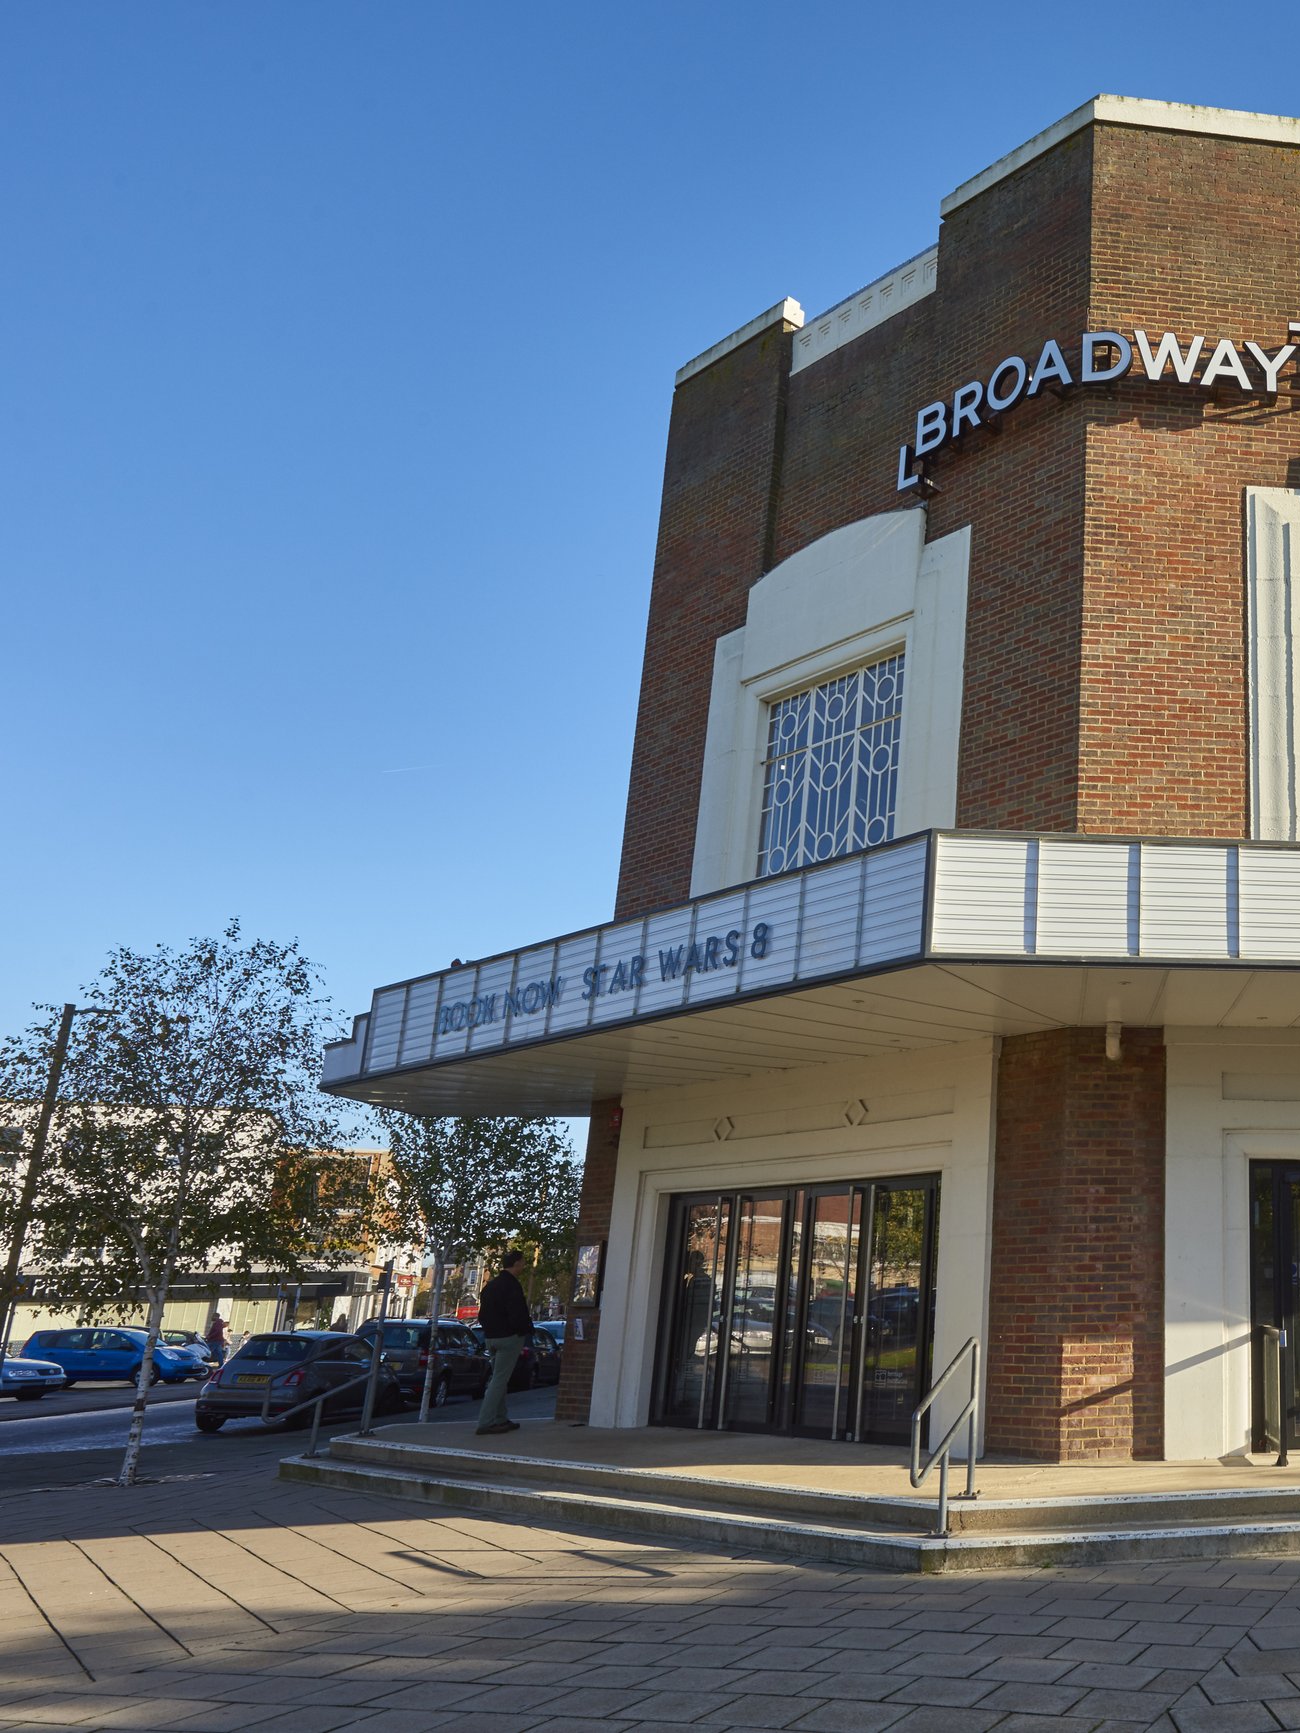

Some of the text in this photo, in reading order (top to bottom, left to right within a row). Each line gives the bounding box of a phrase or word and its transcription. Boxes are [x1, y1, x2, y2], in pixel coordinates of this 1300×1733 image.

[914, 329, 1298, 458] BROADWAY
[438, 922, 769, 1035] BOOK NOW STAR WARS 8
